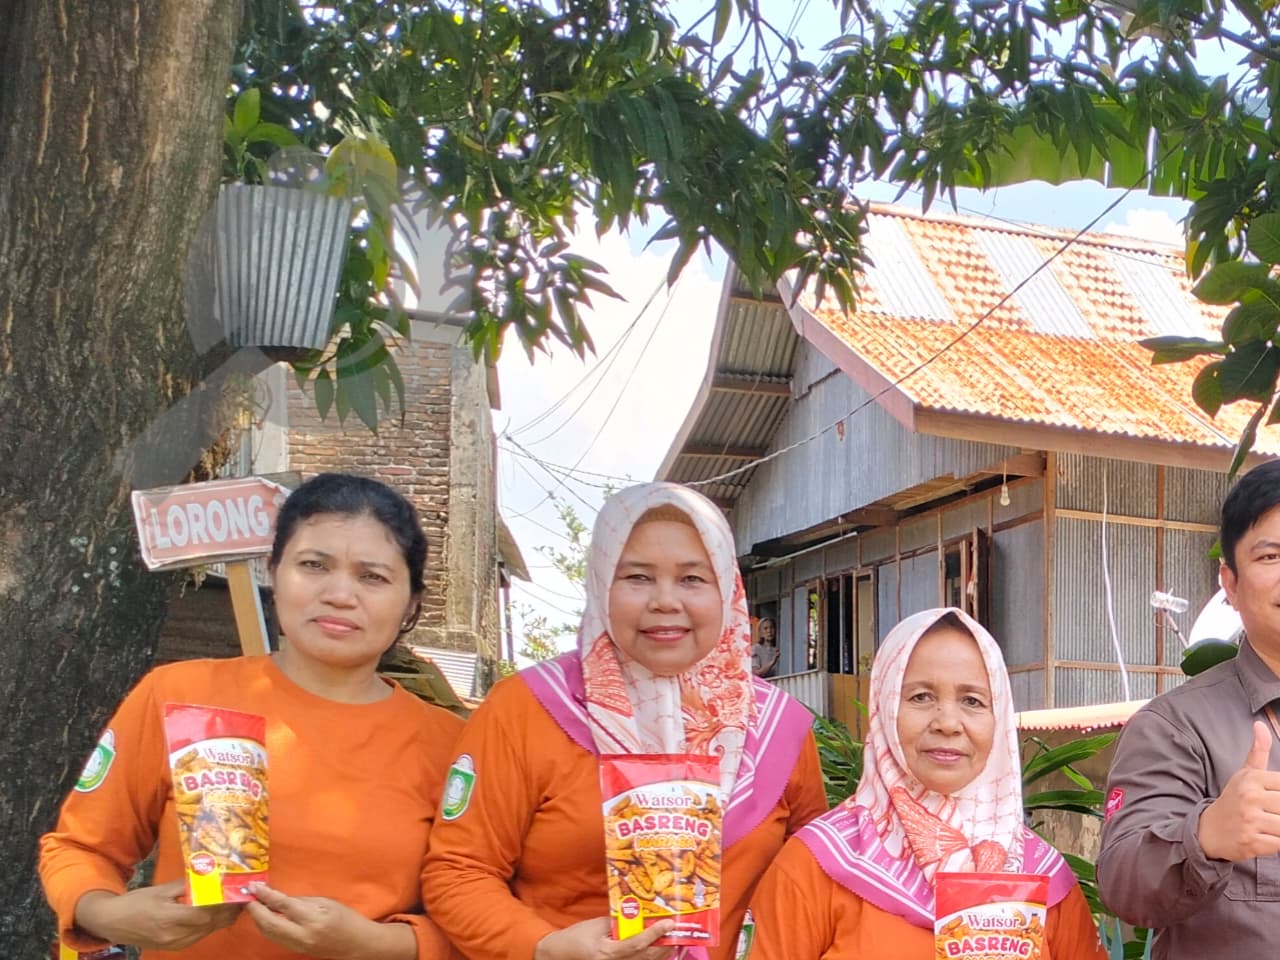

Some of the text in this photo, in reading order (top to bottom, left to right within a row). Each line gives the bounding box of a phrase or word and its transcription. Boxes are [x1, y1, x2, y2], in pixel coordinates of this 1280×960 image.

[150, 494, 270, 549] LORONG
[635, 793, 692, 807] Watsor
[617, 815, 710, 839] BASRENG
[967, 914, 1020, 928] Watsor
[947, 936, 1031, 957] BASRENG
